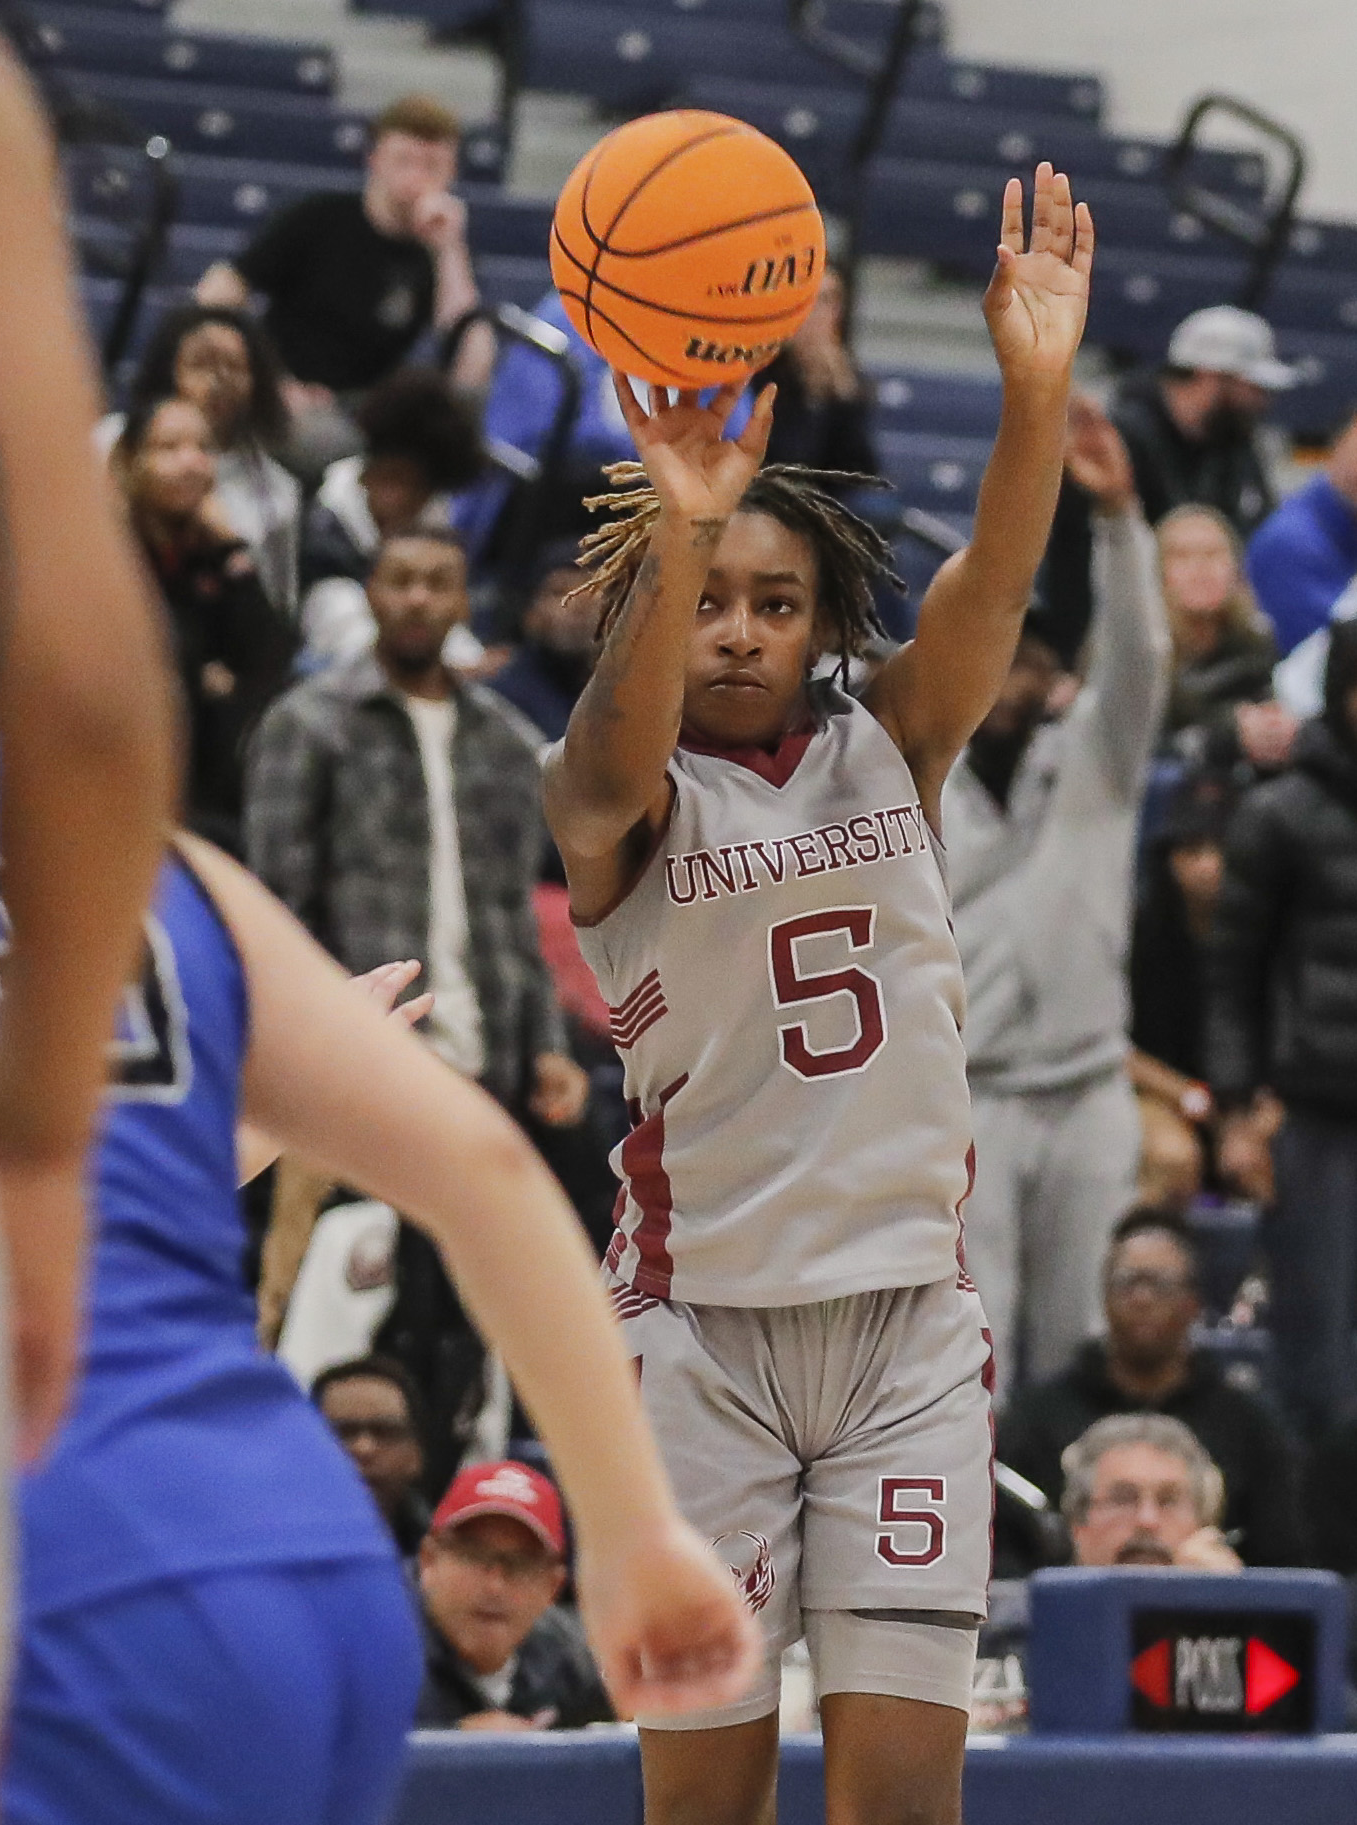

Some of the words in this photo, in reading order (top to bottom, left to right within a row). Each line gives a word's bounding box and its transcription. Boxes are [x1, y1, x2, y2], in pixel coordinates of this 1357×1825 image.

[666, 802, 926, 906] UNIVERSITY
[766, 904, 889, 1083] 5
[875, 1475, 946, 1569] 5
